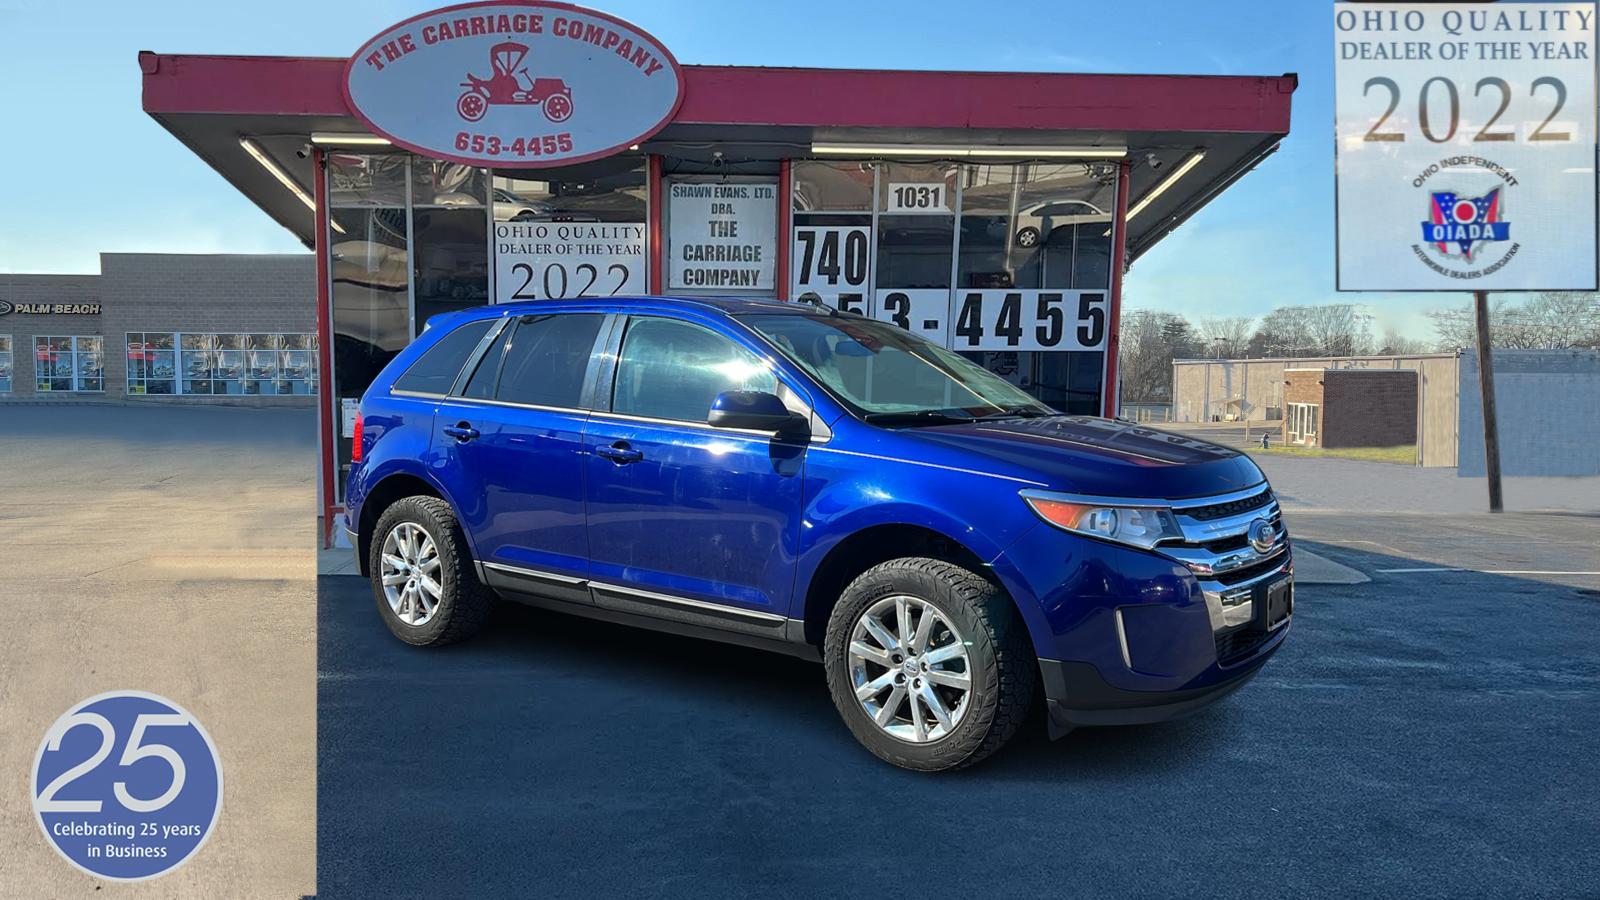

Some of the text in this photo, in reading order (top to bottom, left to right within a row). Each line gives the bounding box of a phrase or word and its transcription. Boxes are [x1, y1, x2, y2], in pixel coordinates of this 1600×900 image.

[1336, 10, 1593, 35] OHIO QUALITY
[365, 14, 664, 77] THE CARRIAGE COMPANY
[1340, 42, 1589, 60] DEALER OF THE YEAR
[1363, 76, 1571, 143] 2022
[455, 132, 573, 157] 653-4455
[1412, 155, 1519, 188] OHIO INDEPENDENT
[672, 186, 712, 198] SHAWN
[754, 187, 774, 199] LTD.
[894, 186, 940, 208] 1031
[711, 203, 736, 215] DBA.
[497, 226, 644, 241] OHIO QUALITY
[708, 221, 738, 238] THE
[1432, 224, 1495, 240] OIADA
[500, 244, 642, 255] DEALER OF THE YEAR
[683, 245, 762, 262] CARRIAGE
[797, 230, 868, 286] 740
[511, 262, 630, 299] 2022
[683, 268, 760, 286] COMPANY
[1449, 269, 1483, 280] DEALERS
[14, 303, 100, 314] PALM BEACH
[798, 292, 1104, 347] 3-4455
